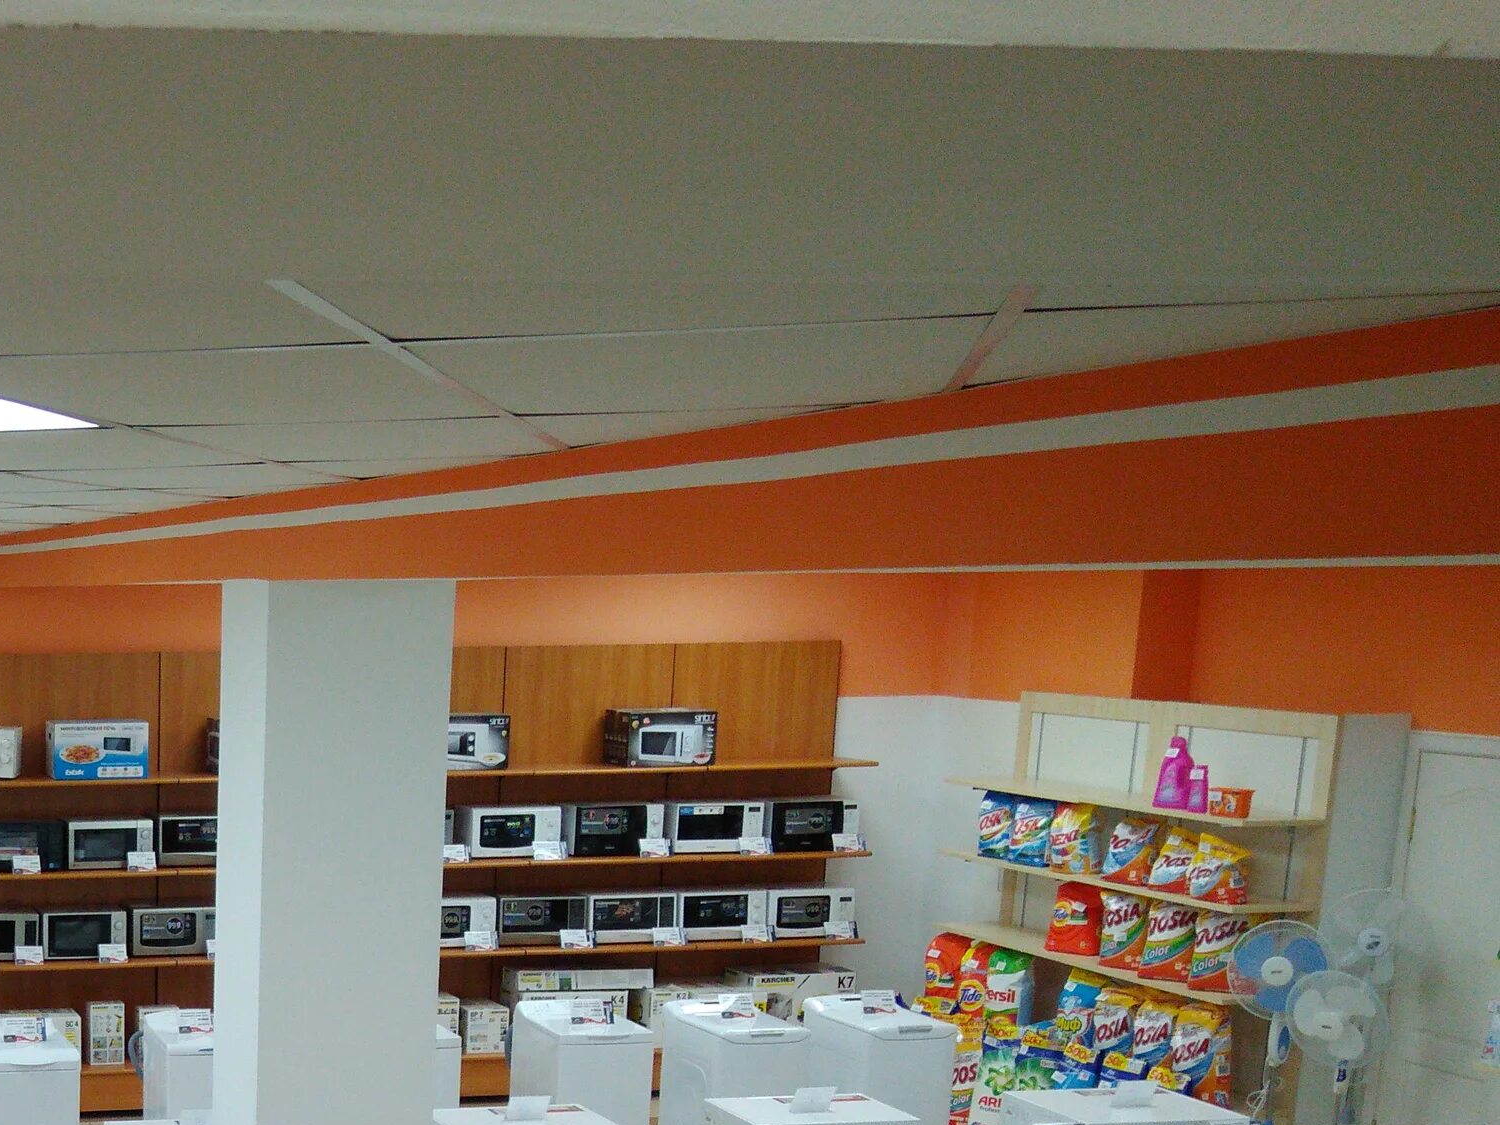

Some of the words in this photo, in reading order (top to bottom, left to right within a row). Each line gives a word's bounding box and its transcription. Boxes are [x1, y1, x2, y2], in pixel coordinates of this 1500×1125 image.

[1106, 902, 1140, 927] OSIA
[1095, 1017, 1128, 1041] OSIA
[1134, 1023, 1168, 1046] OSIA
[952, 1063, 979, 1086] DOS
[978, 1096, 1002, 1108] ARI
